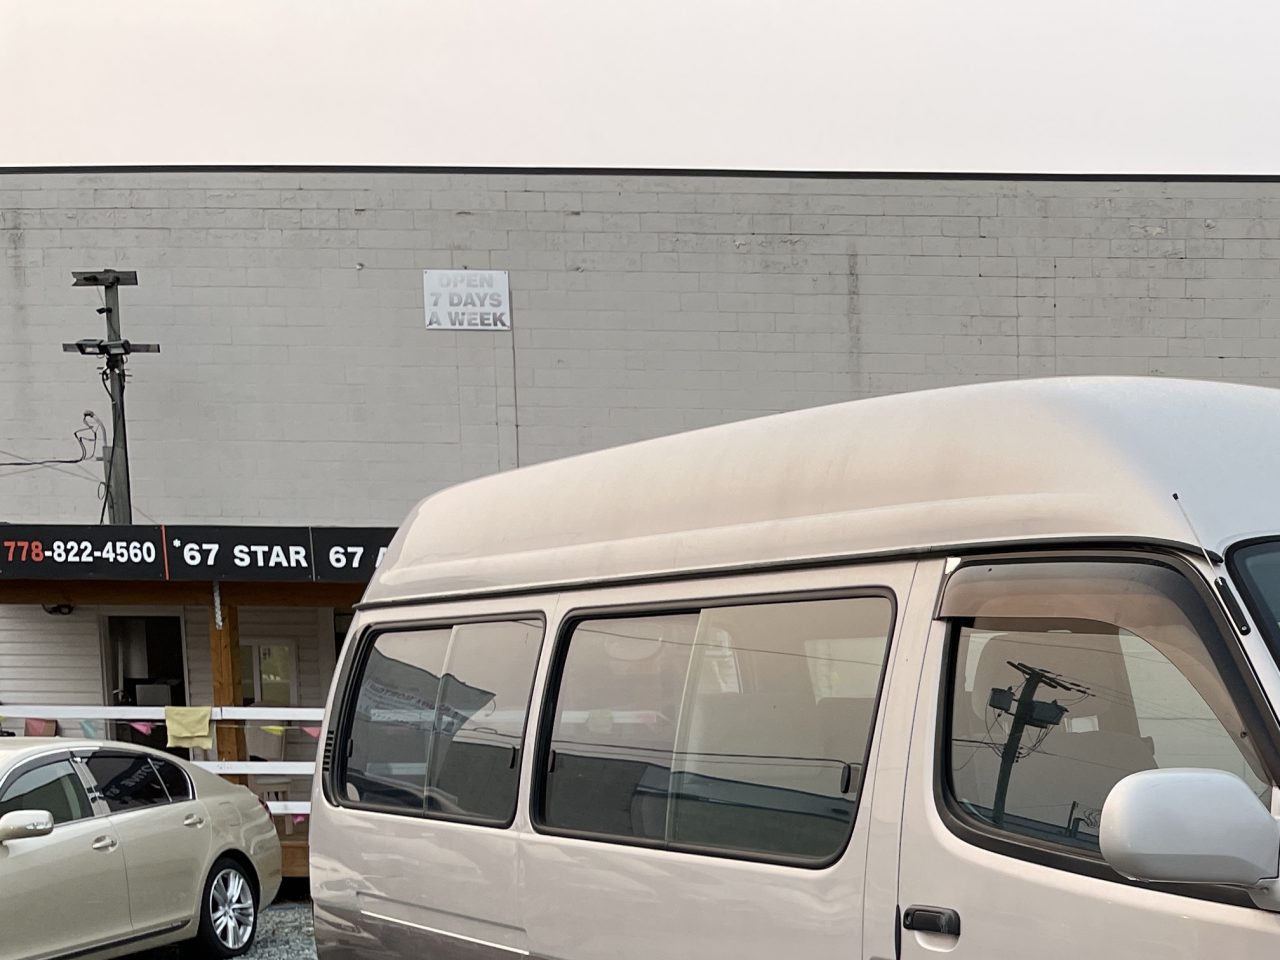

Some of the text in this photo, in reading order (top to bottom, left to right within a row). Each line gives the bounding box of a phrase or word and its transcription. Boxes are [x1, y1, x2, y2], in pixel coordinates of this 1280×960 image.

[439, 273, 494, 288] OPEN
[430, 292, 503, 308] 7 DAYS
[428, 311, 507, 327] A WEEK
[3, 540, 156, 564] 778-822-4560
[233, 544, 309, 568] STAR
[328, 545, 364, 569] 67
